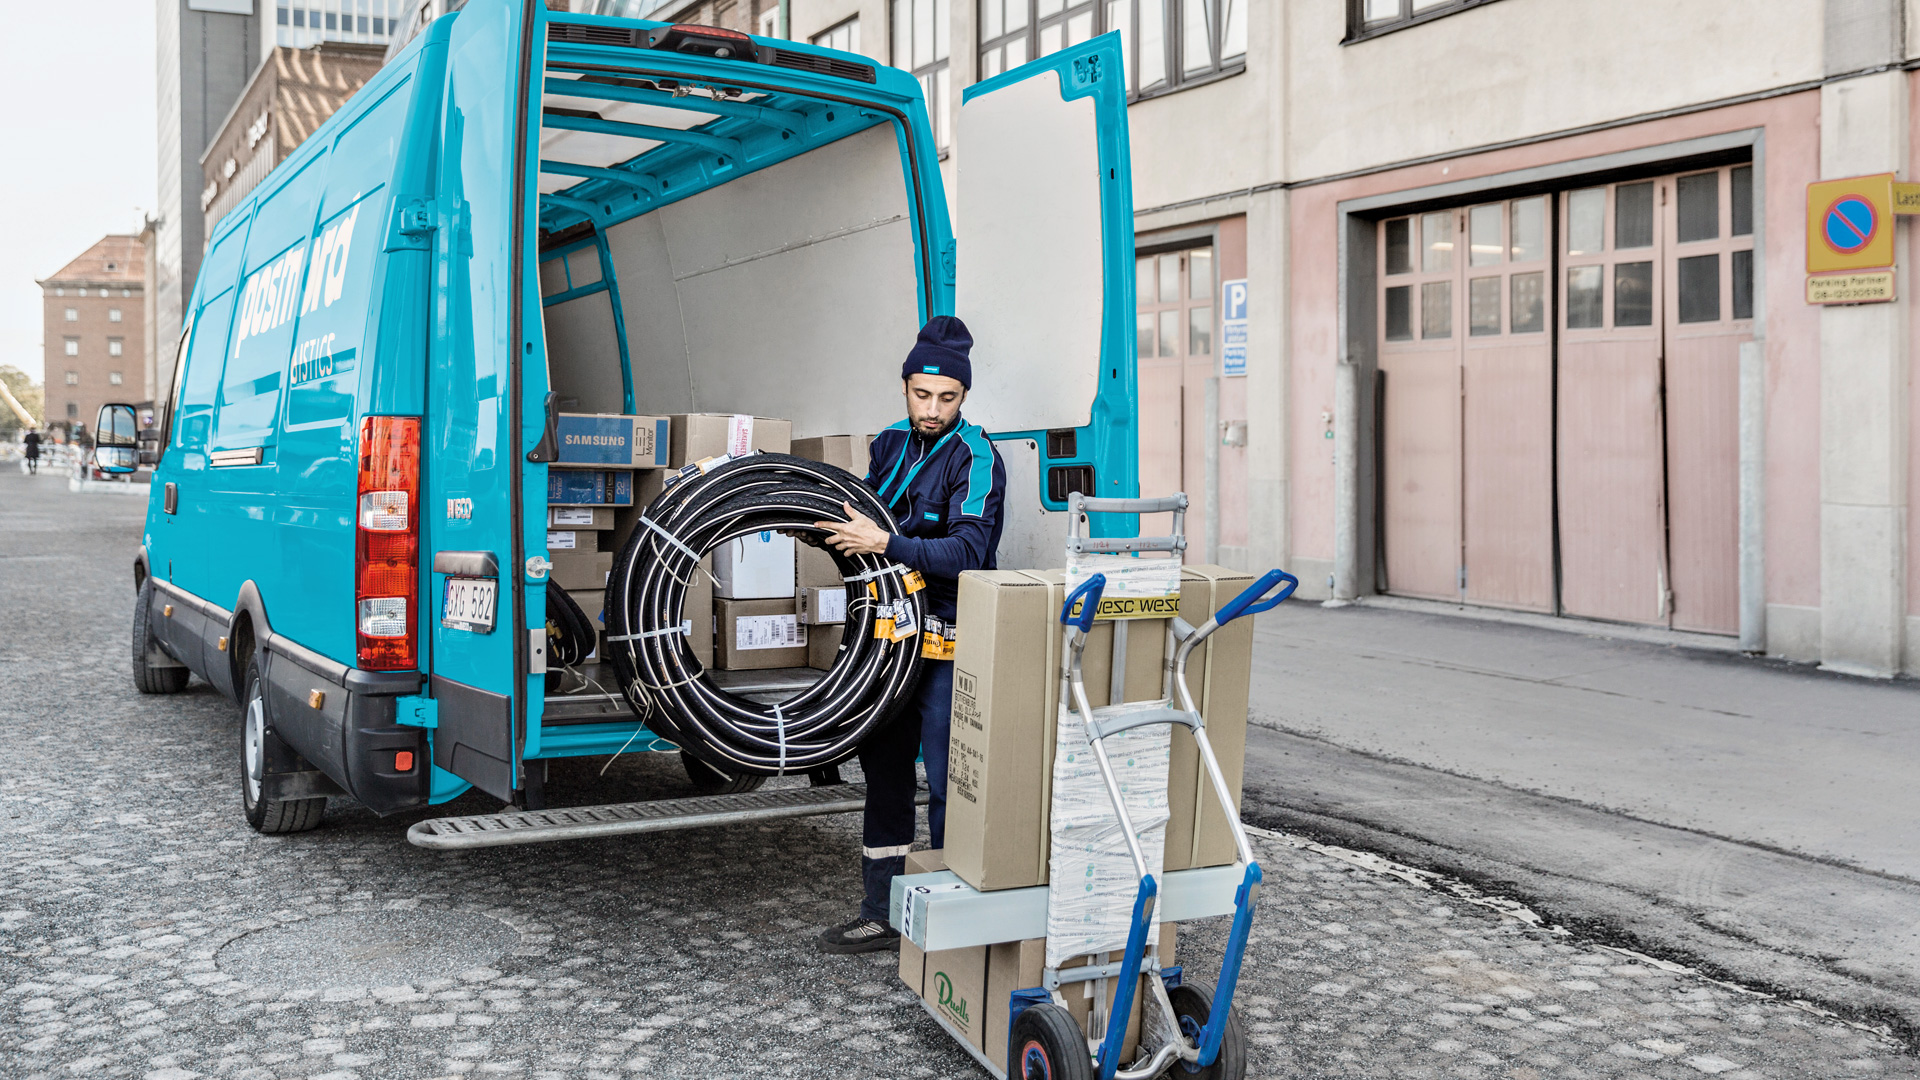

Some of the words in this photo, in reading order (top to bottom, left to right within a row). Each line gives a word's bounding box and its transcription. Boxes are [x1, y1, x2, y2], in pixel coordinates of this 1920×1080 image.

[1810, 279, 1847, 287] Parking
[1850, 276, 1887, 285] Partner
[1231, 284, 1246, 319] P
[565, 434, 625, 446] SAMSUNG
[646, 428, 654, 456] Monitor
[616, 481, 625, 495] 22
[448, 584, 466, 617] GXG
[471, 586, 493, 620] 582
[934, 971, 970, 1023] Duells
